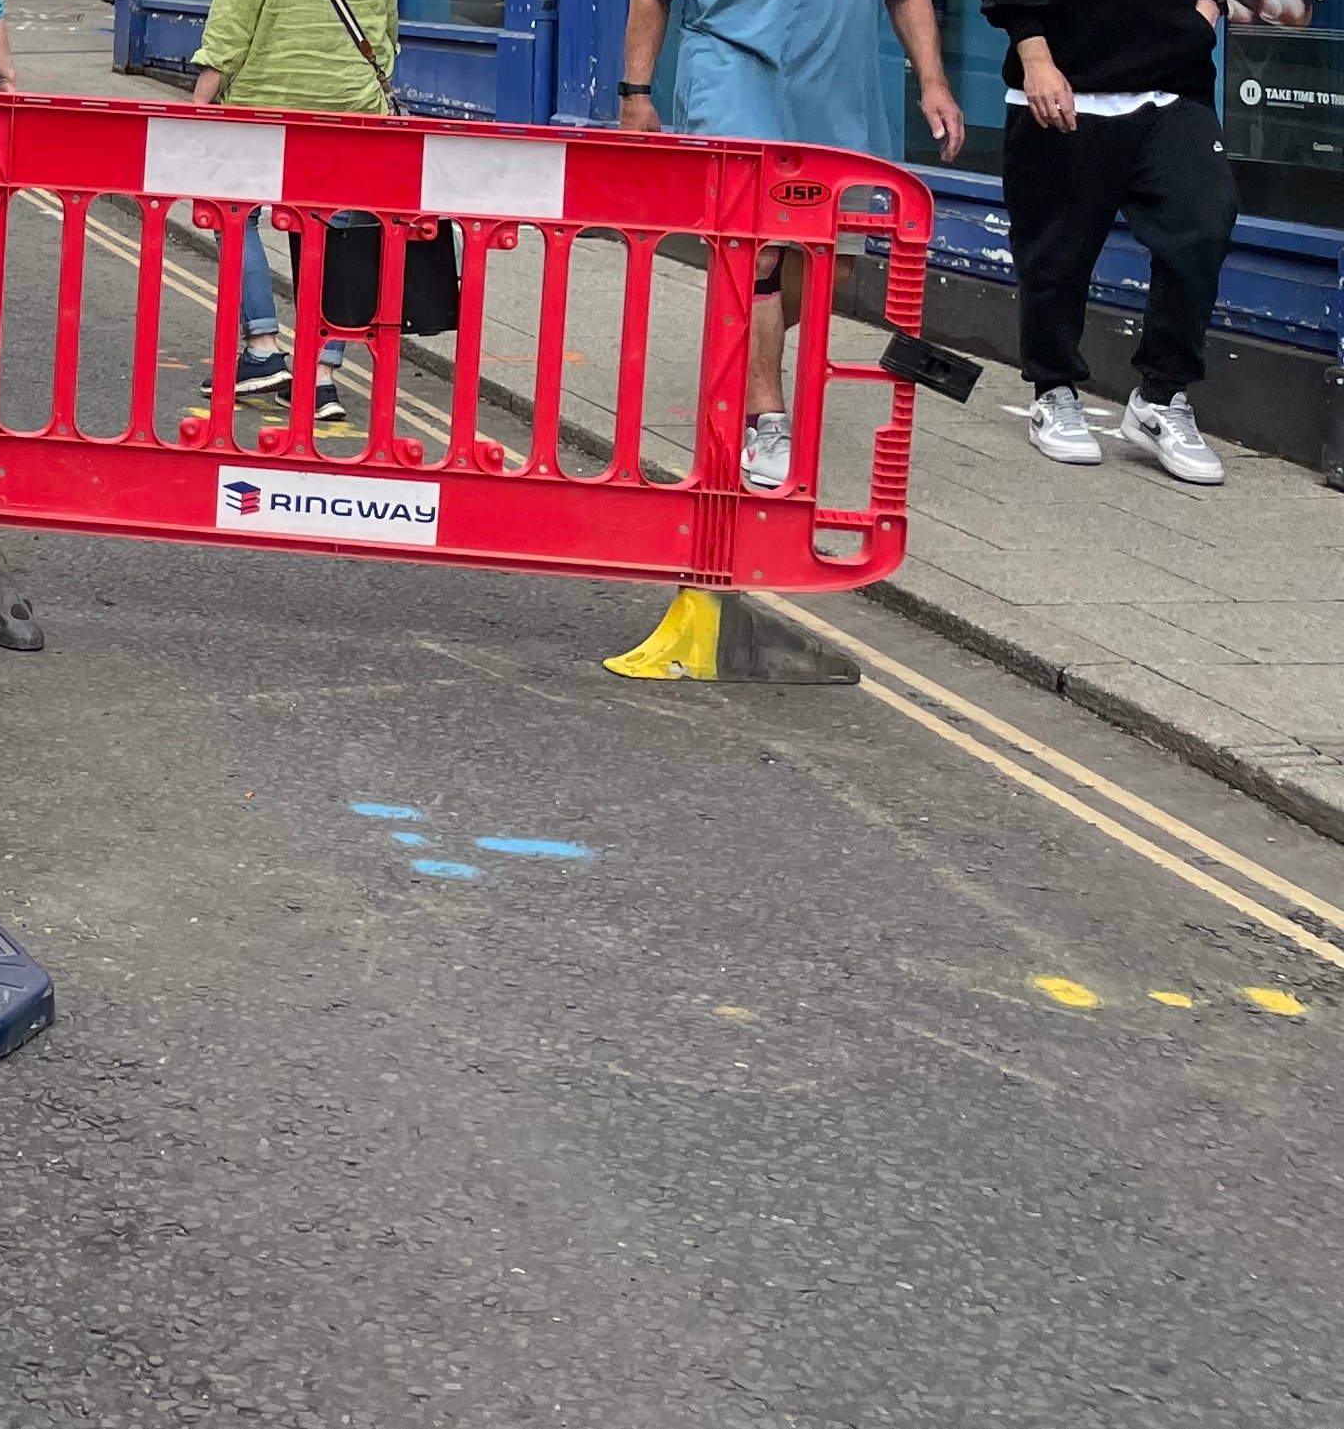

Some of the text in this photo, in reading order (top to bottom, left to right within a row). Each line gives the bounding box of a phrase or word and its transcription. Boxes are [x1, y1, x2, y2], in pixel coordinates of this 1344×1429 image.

[1265, 87, 1292, 101] TAKE
[1293, 90, 1315, 103] TIME
[1316, 92, 1330, 105] TO
[779, 185, 823, 201] JSP
[270, 493, 437, 524] RINGWAY
